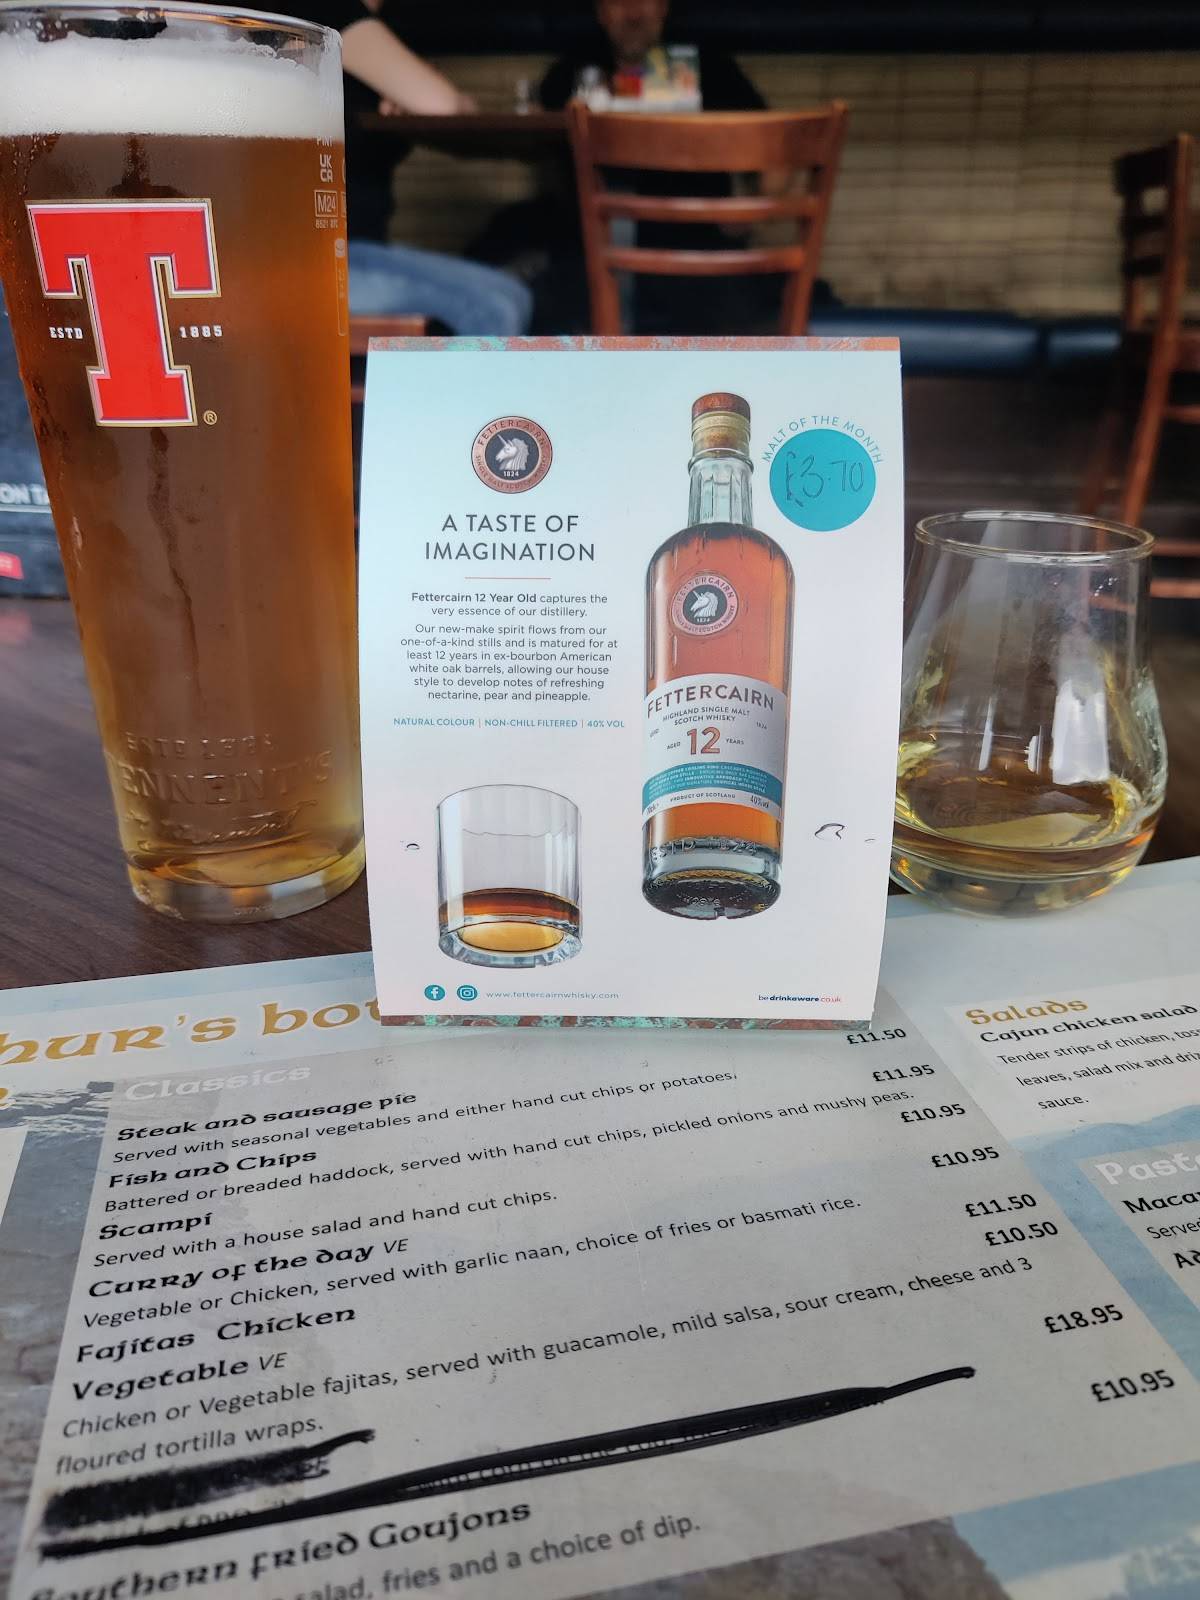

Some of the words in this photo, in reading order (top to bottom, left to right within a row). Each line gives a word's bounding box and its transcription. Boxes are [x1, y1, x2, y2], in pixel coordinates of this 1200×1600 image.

[320, 153, 332, 168] UK
[317, 194, 336, 213] M24
[25, 198, 221, 427] T
[49, 327, 83, 339] ESTD
[180, 326, 222, 338] 1885
[478, 419, 544, 448] FETTERCAIRN
[762, 429, 787, 462] MALT
[789, 417, 808, 431] OF
[812, 416, 840, 426] THE
[843, 421, 884, 463] MONTH
[441, 514, 458, 532] A
[465, 514, 537, 533] TASTE
[545, 514, 579, 533] OF
[425, 541, 595, 562] IMAGINATION
[411, 592, 472, 603] Fettercairn
[474, 593, 487, 603] 12
[489, 592, 514, 603] Year
[516, 593, 537, 603] Old
[539, 594, 587, 605] captures
[590, 594, 608, 604] the
[431, 607, 455, 617] very
[457, 607, 502, 616] essence
[503, 606, 517, 616] of
[518, 608, 538, 617] our
[539, 606, 588, 618] distillery.
[415, 623, 436, 634] Our
[438, 624, 495, 635] new-make
[497, 624, 525, 636] spirit
[528, 624, 558, 635] flows
[559, 625, 586, 635] from
[588, 627, 607, 636] our
[400, 637, 475, 648] one-of-a-kind
[477, 637, 502, 648] stills
[504, 637, 526, 648] and
[528, 637, 537, 648] is
[539, 638, 586, 649] matured
[588, 638, 605, 649] for
[607, 639, 618, 649] at
[406, 650, 433, 660] least
[435, 650, 446, 660] 12
[448, 652, 478, 663] years
[481, 650, 491, 661] in
[493, 650, 557, 662] ex-bourbon
[559, 651, 612, 662] American
[409, 663, 439, 673] white
[441, 663, 462, 674] oak
[464, 663, 505, 675] barrels,
[507, 664, 553, 677] allowing
[555, 666, 575, 675] our
[577, 664, 610, 675] house
[414, 676, 440, 688] style
[442, 677, 454, 687] to
[457, 676, 501, 689] develop
[503, 678, 534, 688] notes
[536, 677, 548, 688] of
[550, 677, 605, 690] refreshing
[428, 690, 481, 701] nectarine,
[484, 692, 509, 702] pear
[511, 690, 532, 701] and
[534, 690, 591, 703] pineapple.
[647, 685, 774, 719] FETTERCAIRN
[393, 717, 433, 727] NATURAL
[437, 717, 475, 727] COLOUR
[484, 718, 535, 728] NON-CHILL
[537, 719, 579, 728] FILTERED
[587, 719, 605, 728] 40%
[606, 719, 625, 728] VOL
[663, 707, 699, 722] HIGHLAND
[731, 708, 750, 716] MALT
[674, 716, 704, 725] SCOTCH
[667, 741, 681, 749] AGED
[687, 726, 721, 755] 12
[670, 794, 695, 802] PRODUCT
[485, 991, 619, 1001] www.fettercairnwhisky.com
[965, 1000, 1089, 1026] Salads
[979, 1027, 1050, 1043] Cajun
[1052, 1015, 1139, 1033] chicken
[1139, 1004, 1199, 1021] salad
[846, 1028, 907, 1045] £11.50
[996, 1050, 1051, 1065] Tender
[1053, 1044, 1096, 1057] strips
[1096, 1039, 1113, 1051] of
[1115, 1034, 1176, 1048] chicken,
[872, 1064, 935, 1082] £11.95
[1016, 1072, 1072, 1087] leaves,
[1073, 1064, 1113, 1079] salad
[1115, 1061, 1144, 1072] mix
[1144, 1055, 1174, 1067] and
[125, 1066, 311, 1101] Classics
[900, 1103, 966, 1123] £10.95
[1037, 1096, 1089, 1110] sauce.
[117, 1121, 198, 1142] Steak
[204, 1113, 257, 1130] and
[263, 1100, 373, 1118] sausage
[378, 1094, 417, 1110] pie
[931, 1146, 1000, 1168] £10.95
[108, 1169, 168, 1189] Fish
[174, 1161, 230, 1180] and
[236, 1151, 317, 1171] Chips
[965, 1193, 1037, 1218] £11.50
[98, 1212, 213, 1240] Scampi
[984, 1221, 1059, 1247] £10.50
[88, 1270, 204, 1298] Curry
[211, 1263, 247, 1282] of
[253, 1255, 308, 1274] the
[315, 1245, 375, 1264] day
[383, 1238, 409, 1254] VE
[1043, 1304, 1124, 1334] £18.95
[76, 1333, 195, 1363] Fajitas
[217, 1309, 356, 1341] Chicken
[62, 1410, 157, 1438] Chicken
[165, 1404, 191, 1421] or
[199, 1382, 316, 1415] Vegetable
[322, 1371, 398, 1395] fajitas,
[405, 1352, 480, 1381] served
[486, 1344, 536, 1366] with
[543, 1324, 666, 1360] guacamole,
[671, 1311, 718, 1334] mild
[723, 1305, 781, 1325] salsa,
[784, 1295, 829, 1314] sour
[835, 1284, 904, 1305] cream,
[907, 1270, 976, 1292] cheese
[978, 1259, 1017, 1279] and
[1018, 1257, 1033, 1271] 3
[72, 1359, 249, 1401] Vegetable
[259, 1352, 287, 1371] VE
[1090, 1369, 1175, 1403] £10.95
[55, 1442, 147, 1476] floured
[155, 1429, 236, 1459] tortilla
[244, 1417, 324, 1443] wraps.
[250, 1531, 360, 1581] Fried
[368, 1503, 531, 1549] Goujons
